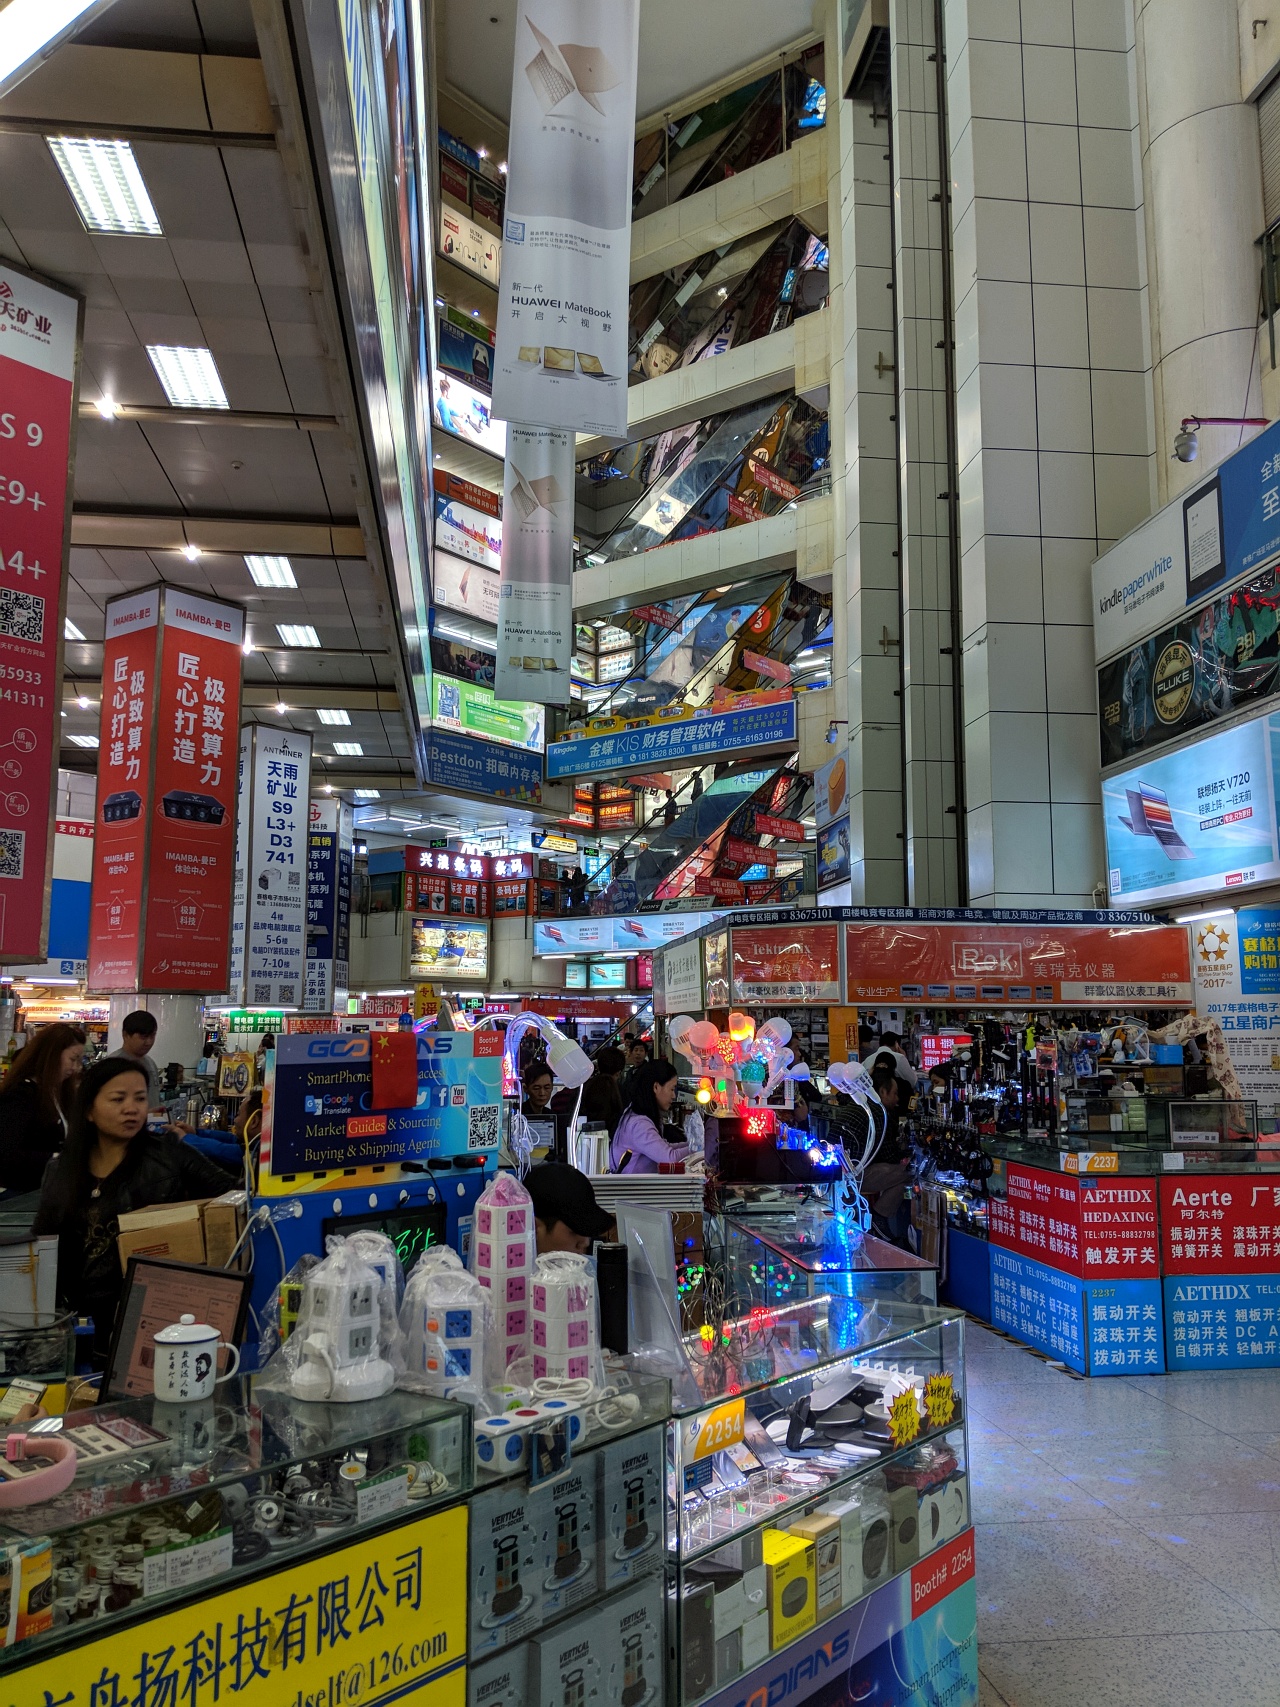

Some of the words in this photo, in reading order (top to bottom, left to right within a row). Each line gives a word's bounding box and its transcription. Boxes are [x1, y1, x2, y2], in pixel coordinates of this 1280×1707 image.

[512, 281, 544, 293] 新一代
[511, 296, 561, 309] HUAWEI
[564, 301, 612, 320] MateBook
[511, 309, 612, 333] 开启大视野
[26, 422, 44, 447] 9
[512, 429, 538, 437] HUAWEI
[1100, 588, 1123, 615] kindle
[1122, 555, 1173, 605] paperwhite
[113, 607, 151, 627] IMAMBA-曼巴
[175, 608, 232, 632] IMAMBA-曼巴
[504, 627, 533, 636] HUAWEI
[533, 628, 562, 637] MateBook
[1236, 630, 1256, 652] 381
[1157, 670, 1190, 695] FLUKE
[109, 656, 129, 767] 匠心打造
[172, 652, 201, 765] 匠心打造
[1104, 701, 1121, 720] 233
[125, 670, 146, 782] 极致算力
[199, 676, 226, 787] 极致算力
[263, 746, 303, 760] ANTMINER
[553, 745, 578, 755] Kingdee
[638, 753, 650, 761] 181
[651, 750, 668, 759] 3828
[668, 746, 685, 757] 8300
[723, 733, 764, 747] 0755-6163
[764, 729, 784, 740] 0196
[431, 746, 483, 771] Bestdon
[267, 760, 299, 781] 天雨
[266, 779, 298, 799] 矿业
[1197, 779, 1226, 800] 联想扬天
[1226, 771, 1251, 789] V720
[272, 801, 293, 815] S9
[266, 816, 296, 832] L3+
[270, 834, 293, 848] D3
[165, 852, 217, 866] IMAMBA-曼巴
[265, 850, 294, 865] 741
[174, 864, 207, 876] 体验中心
[495, 858, 523, 876] 条码
[1226, 874, 1242, 884] Lenovo
[1243, 870, 1256, 881] 联想
[496, 883, 526, 896] 条码世界
[270, 911, 284, 921] 4楼
[789, 908, 833, 921] 83675101
[842, 908, 914, 919] 四楼电竞专区招商
[1108, 911, 1156, 923] 83675101
[253, 922, 301, 933] 品牌电脑旗舰店
[266, 935, 288, 945] 5-6楼
[262, 958, 290, 969] 7-10楼
[1033, 962, 1116, 979] 美瑞克仪器
[856, 986, 898, 997] 专业生产:
[1084, 985, 1177, 997] 群豪仪器仪表工具行
[1203, 978, 1226, 988] 2017
[478, 1036, 499, 1045] Booth#
[478, 1046, 492, 1055] 2254
[307, 1068, 372, 1087] SmartPhone
[323, 1093, 354, 1106] Google
[453, 1087, 465, 1096] You
[323, 1107, 352, 1115] Translate
[305, 1124, 346, 1138] Market
[347, 1119, 386, 1134] Guides
[388, 1119, 398, 1130] &
[398, 1116, 442, 1132] Sourcing
[304, 1148, 345, 1164] Buying
[346, 1145, 357, 1157] &
[359, 1141, 406, 1159] Shipping
[407, 1139, 441, 1154] Agents
[1066, 1157, 1079, 1171] 2237
[1093, 1156, 1117, 1169] 2237
[1008, 1174, 1032, 1190] AETHDX
[1033, 1179, 1051, 1195] Aerte
[1054, 1186, 1076, 1203] 厂家直销
[1008, 1186, 1032, 1201] HEDAXING
[1083, 1189, 1153, 1204] AETHDX
[1172, 1187, 1233, 1207] Aerte
[991, 1201, 1015, 1222] 振动开关
[1019, 1209, 1046, 1231] 滚珠开关
[1083, 1212, 1155, 1223] HEDAXING
[1181, 1208, 1225, 1220] 阿尔特
[991, 1217, 1016, 1238] 弹簧开关
[1019, 1227, 1046, 1249] 震动开关
[1084, 1230, 1156, 1239] TEL:0755-88832798
[1170, 1226, 1223, 1241] 振动开关
[1085, 1246, 1156, 1265] 触发开关
[1171, 1244, 1223, 1259] 弹簧开关
[993, 1252, 1023, 1276] AETHDX
[1025, 1266, 1077, 1294] TEL:0755-88832798
[993, 1272, 1017, 1296] 微动开关
[1092, 1288, 1116, 1298] 2237
[1173, 1284, 1252, 1302] AETHDX
[993, 1289, 1018, 1313] 拨动开关
[1020, 1303, 1031, 1317] DC
[1036, 1311, 1047, 1325] AC
[1092, 1304, 1157, 1322] 振动开关
[995, 1306, 1019, 1330] 自锁开关
[1020, 1318, 1048, 1344] 轻触开关
[1172, 1309, 1228, 1324] 微动开关
[1093, 1326, 1158, 1343] 滚珠开关
[1173, 1326, 1228, 1341] 拨动开关
[1235, 1325, 1257, 1338] DC
[1094, 1348, 1158, 1366] 拨动开关
[1175, 1343, 1229, 1358] 自锁开关
[705, 1414, 742, 1448] 2254
[622, 1452, 649, 1470] VERTICAL
[552, 1475, 582, 1496] VERTICAL
[491, 1505, 525, 1528] VERTICAL
[913, 1565, 947, 1603] Booth#
[951, 1550, 973, 1577] 2254
[619, 1607, 647, 1628] VERTICAL
[559, 1640, 590, 1661] VERTICAL
[476, 1672, 511, 1697] VERTICAL
